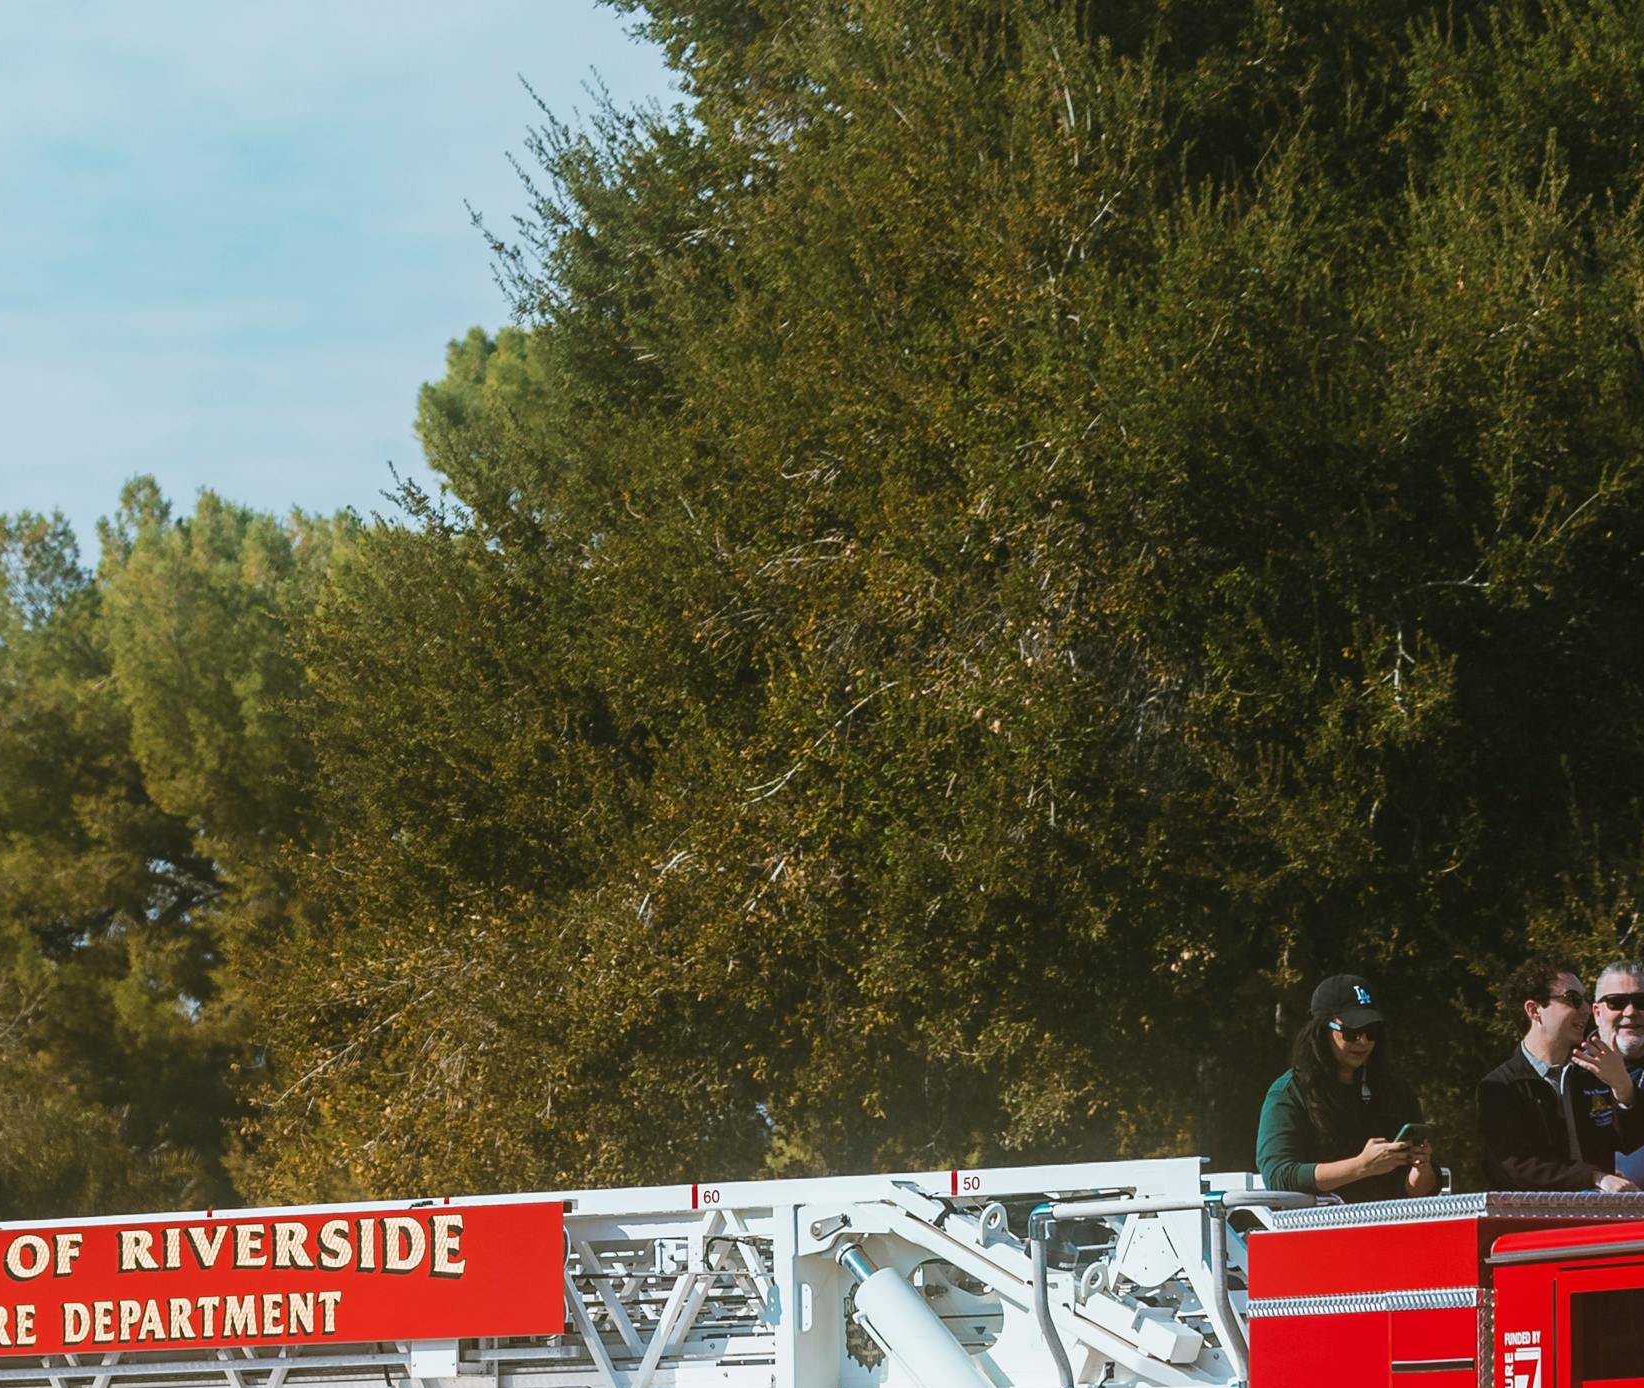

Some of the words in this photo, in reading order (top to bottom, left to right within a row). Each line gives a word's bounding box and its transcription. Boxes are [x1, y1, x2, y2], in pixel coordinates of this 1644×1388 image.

[963, 1176, 980, 1192] 50
[703, 1189, 720, 1205] 60
[5, 1233, 83, 1282] OF
[118, 1215, 466, 1279] RIVERSIDE
[62, 1291, 342, 1344] DEPARTMENT
[1504, 1332, 1531, 1346] FUNDED
[1532, 1331, 1541, 1344] BY
